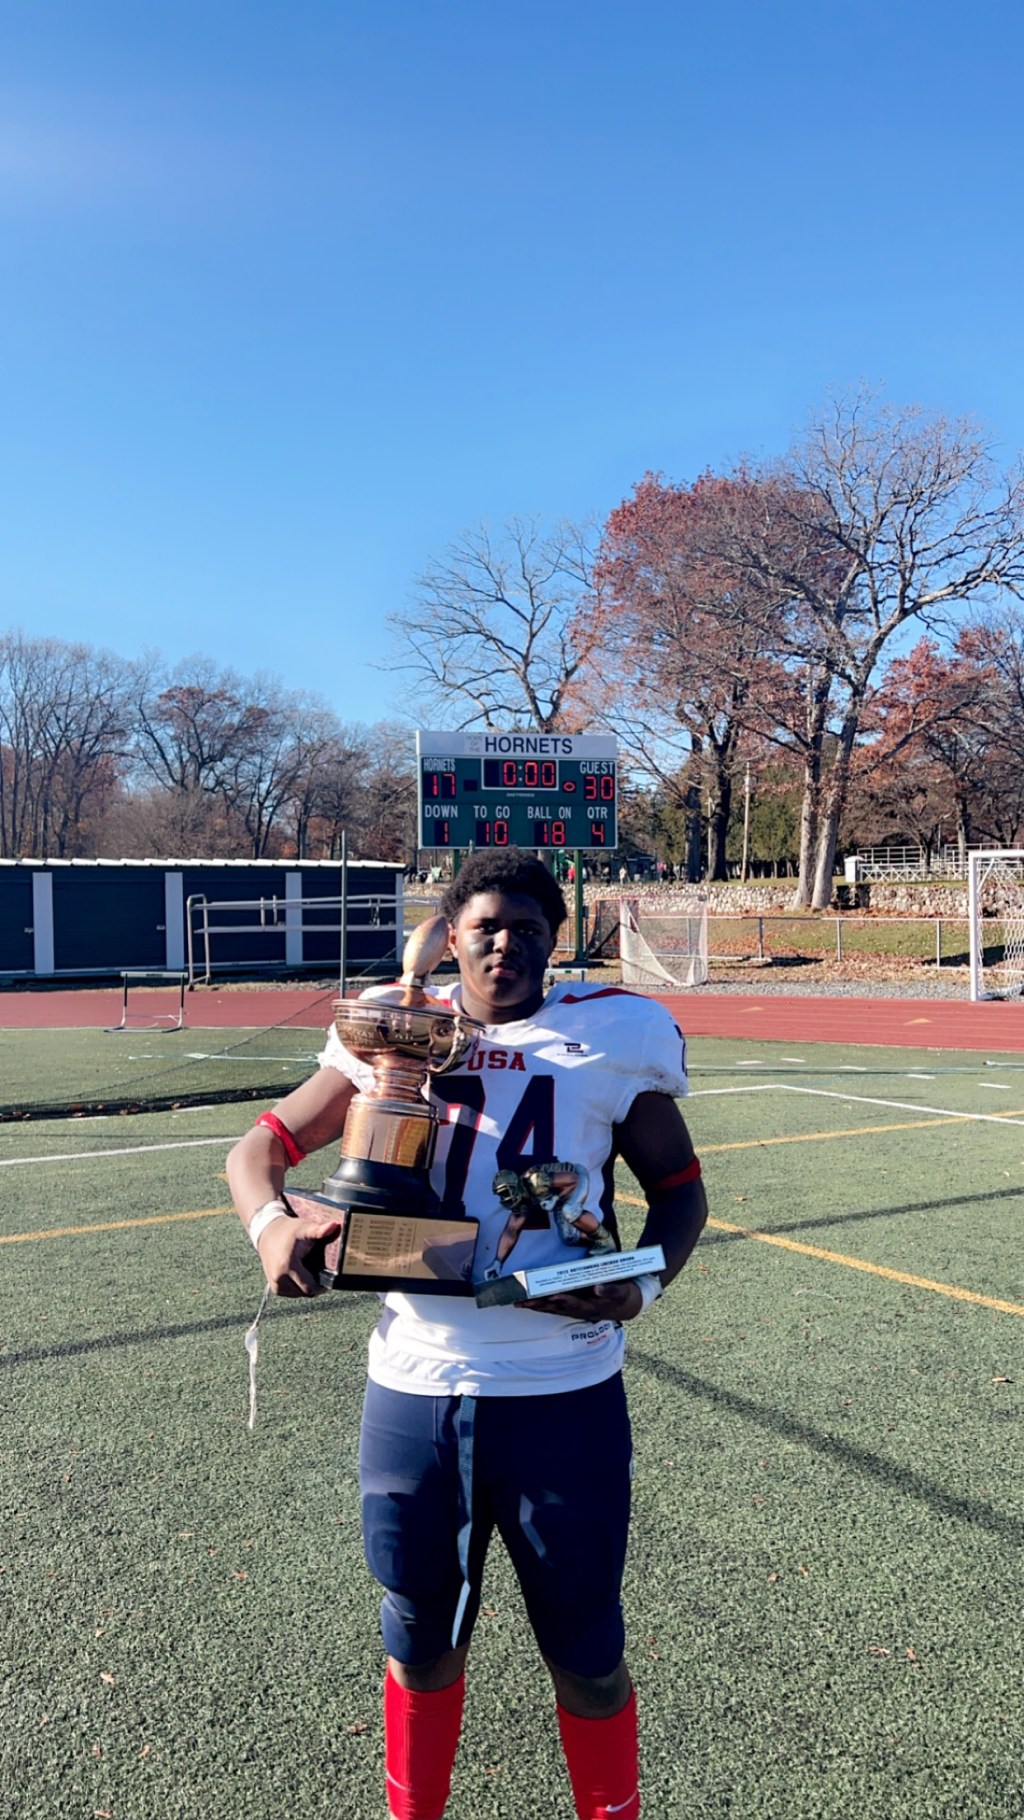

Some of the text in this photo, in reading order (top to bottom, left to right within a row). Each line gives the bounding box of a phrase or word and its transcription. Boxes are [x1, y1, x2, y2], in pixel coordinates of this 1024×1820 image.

[485, 736, 573, 754] HORNETS
[423, 758, 456, 772] HORNETS
[503, 761, 555, 786] 0:00
[580, 761, 614, 775] GUEST
[433, 773, 456, 796] 17
[585, 775, 614, 800] 30
[424, 805, 459, 818] DOWN
[473, 805, 511, 819] TO GO
[527, 806, 572, 819] BALL ON
[587, 807, 608, 819] QTR
[485, 820, 508, 845] 10
[543, 821, 566, 845] 18
[591, 823, 605, 844] 4
[467, 1050, 527, 1071] USA
[430, 1075, 558, 1229] 74
[571, 1323, 611, 1341] PROLOO
